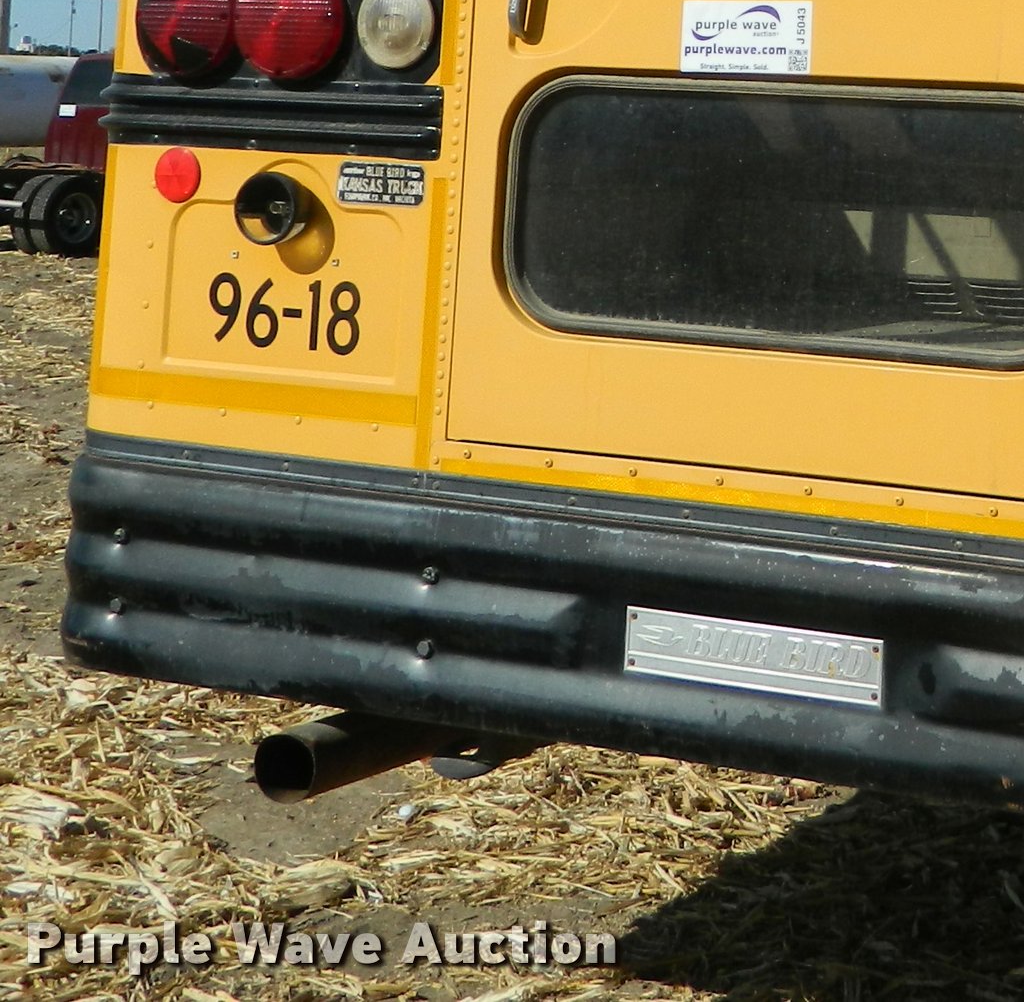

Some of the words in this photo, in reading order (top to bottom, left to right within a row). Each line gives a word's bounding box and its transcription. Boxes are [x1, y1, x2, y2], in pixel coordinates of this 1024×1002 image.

[695, 19, 737, 32] purple
[743, 21, 777, 30] wave
[684, 43, 787, 56] purplewave.com
[700, 63, 726, 71] Straight.
[728, 63, 750, 71] Simple.
[342, 177, 383, 193] KANSAS
[209, 272, 361, 356] 96-18
[686, 624, 772, 666] BLUE
[778, 636, 873, 679] BIRD
